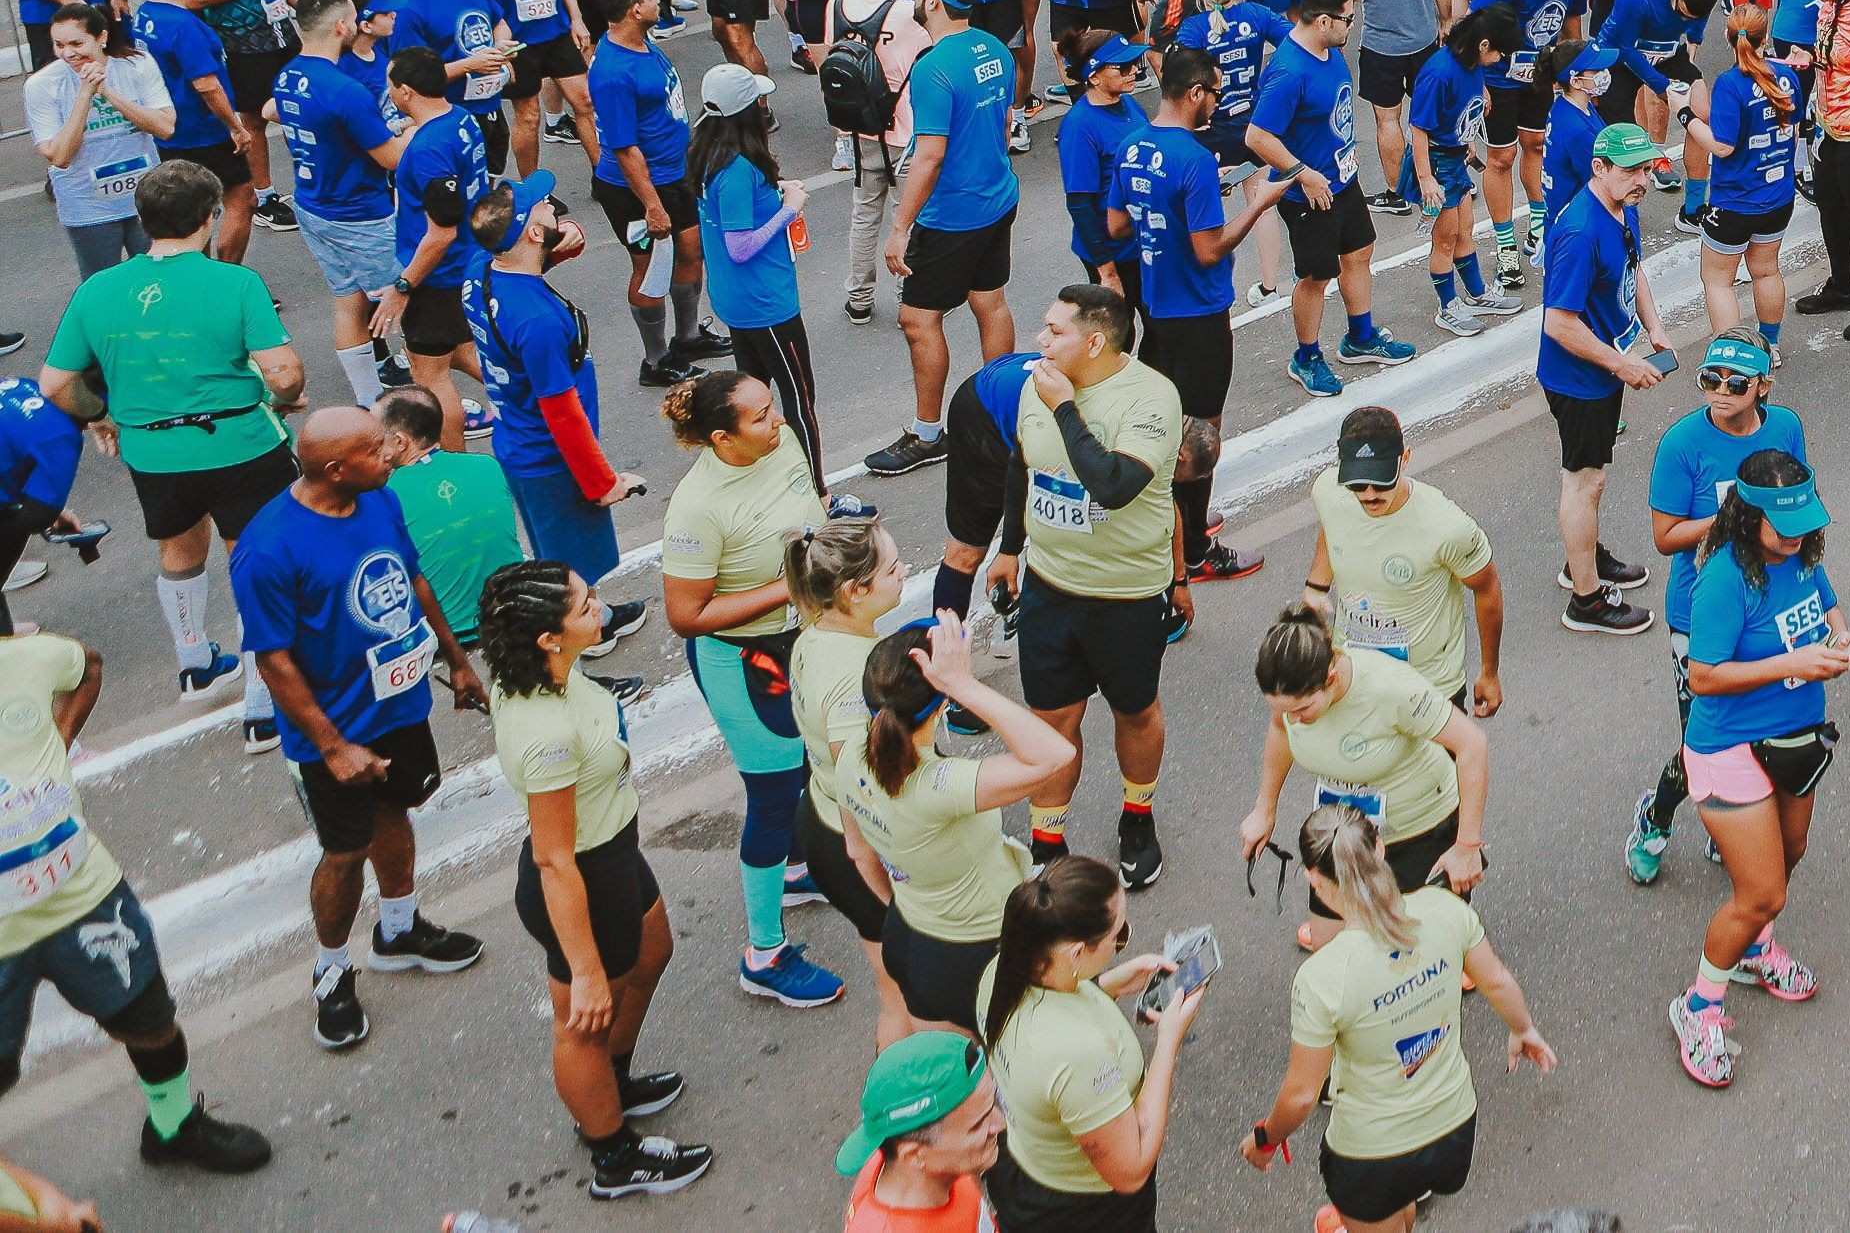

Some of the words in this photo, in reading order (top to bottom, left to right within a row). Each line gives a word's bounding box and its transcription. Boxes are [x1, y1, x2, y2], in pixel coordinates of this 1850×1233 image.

[527, 1, 554, 17] 529
[1540, 16, 1562, 32] EIS
[470, 28, 493, 45] EIS
[1222, 49, 1246, 62] SESI
[978, 61, 1002, 81] SESI
[1033, 497, 1085, 526] 4018
[379, 576, 410, 608] EIS
[1372, 958, 1450, 1012] FORTUNA
